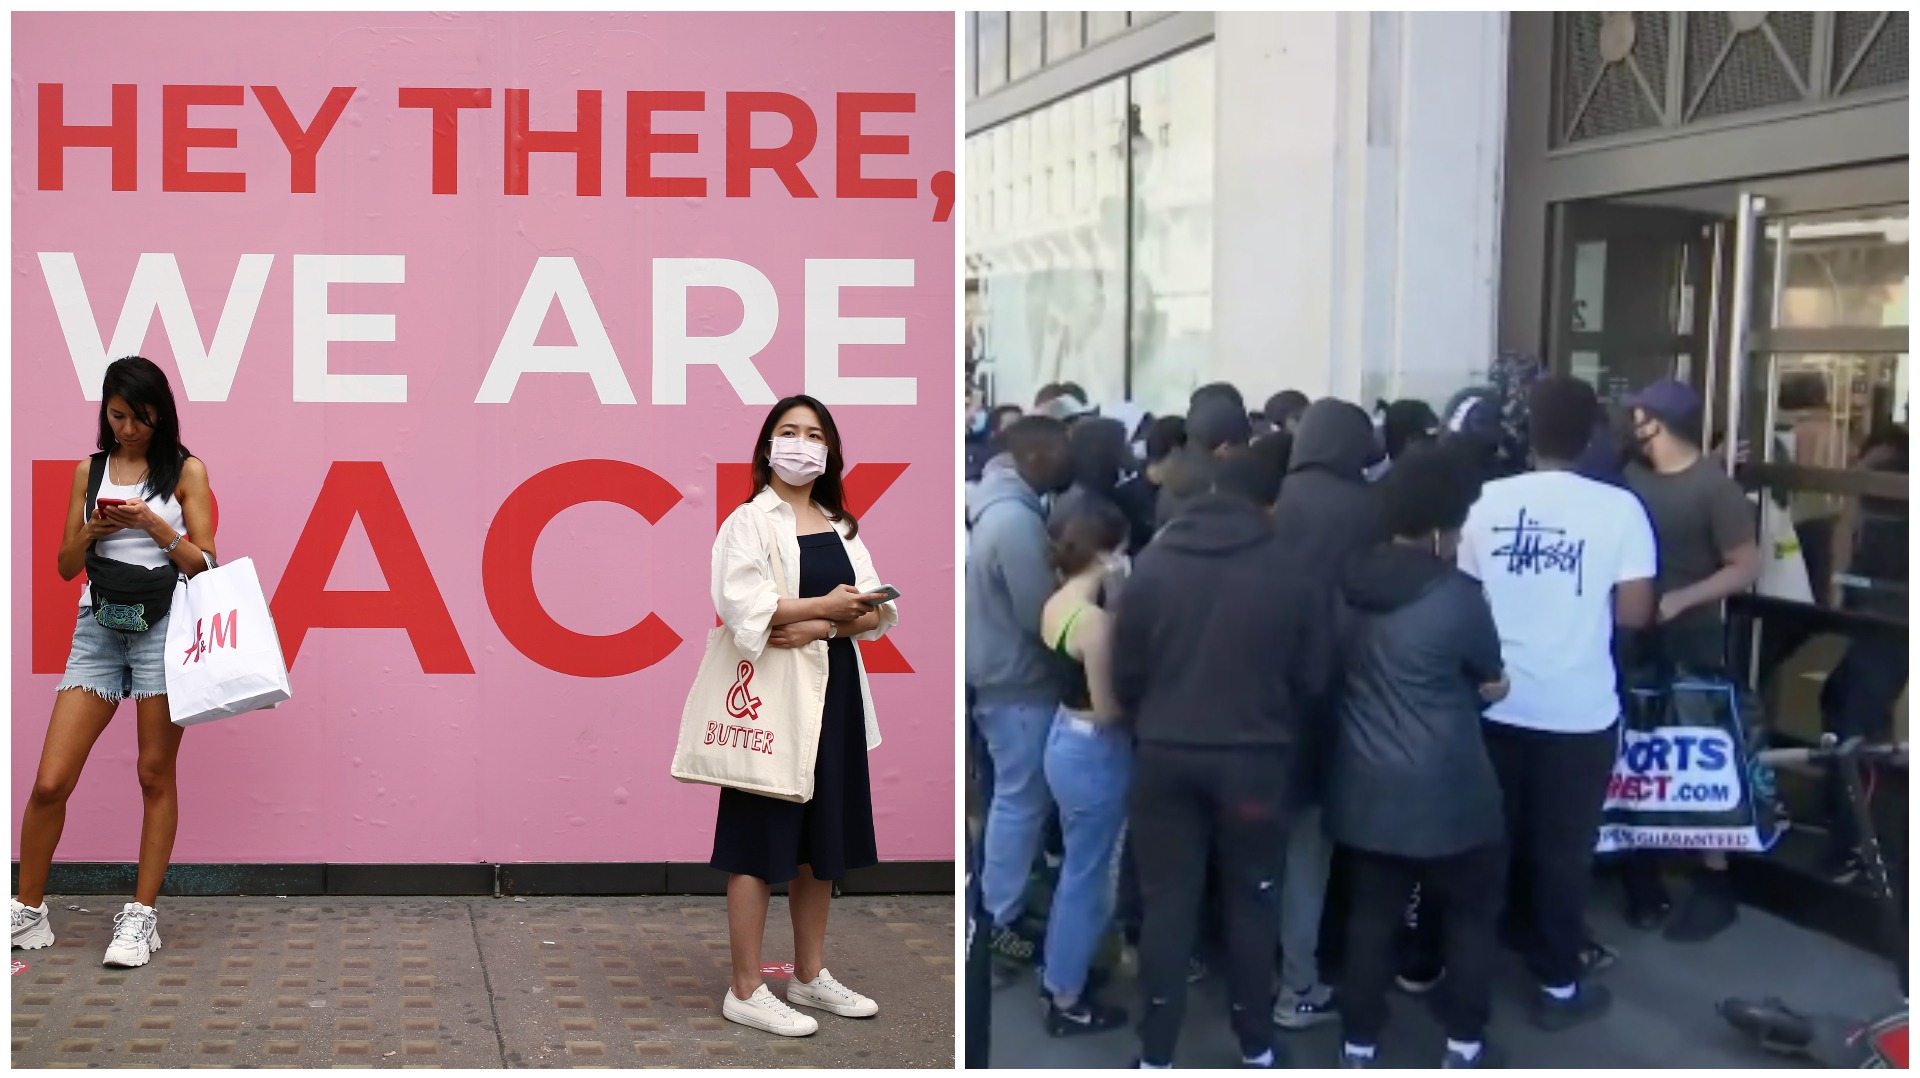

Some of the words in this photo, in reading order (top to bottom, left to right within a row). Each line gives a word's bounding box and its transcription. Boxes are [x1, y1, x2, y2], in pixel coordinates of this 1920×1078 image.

[37, 82, 358, 194] HEY
[398, 86, 955, 222] THERE,
[36, 252, 409, 404] WE
[473, 256, 918, 405] ARE
[725, 659, 763, 720] &
[703, 720, 775, 755] BUTTER
[1622, 735, 1728, 774] ORTS
